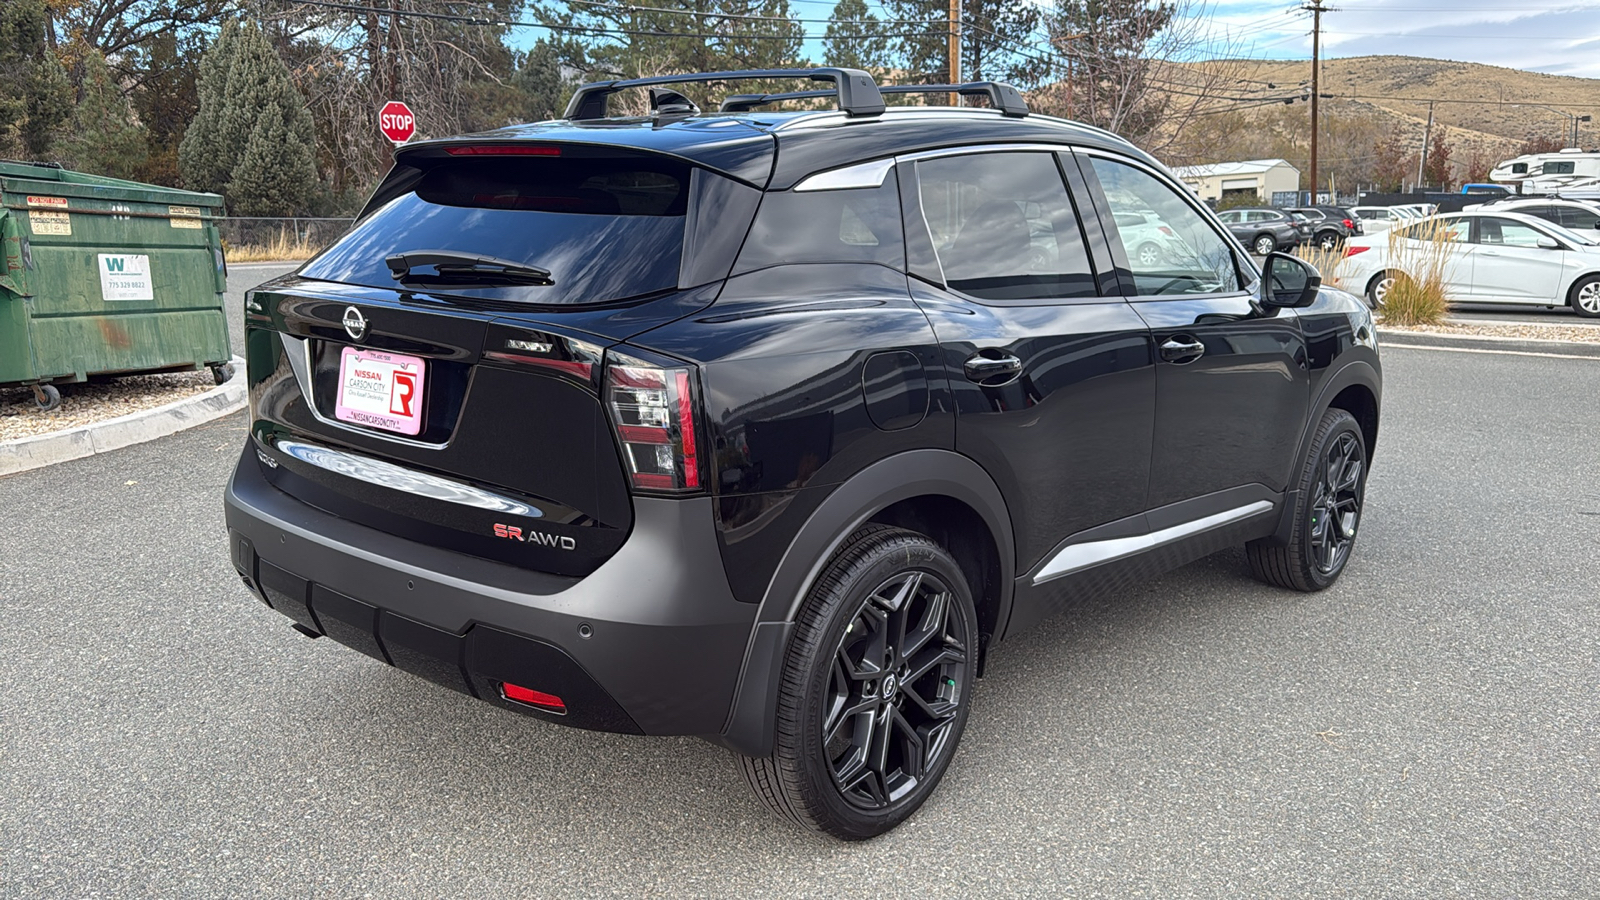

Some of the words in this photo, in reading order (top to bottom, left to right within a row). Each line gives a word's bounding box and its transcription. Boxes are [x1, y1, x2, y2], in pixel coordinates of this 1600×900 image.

[382, 113, 413, 131] STOP
[131, 281, 145, 289] 8822
[343, 319, 366, 328] NISSAN
[354, 369, 382, 381] NISSAN
[349, 378, 373, 389] CARSON
[373, 382, 386, 392] CITY
[493, 522, 525, 542] SR
[527, 530, 576, 551] AWD
